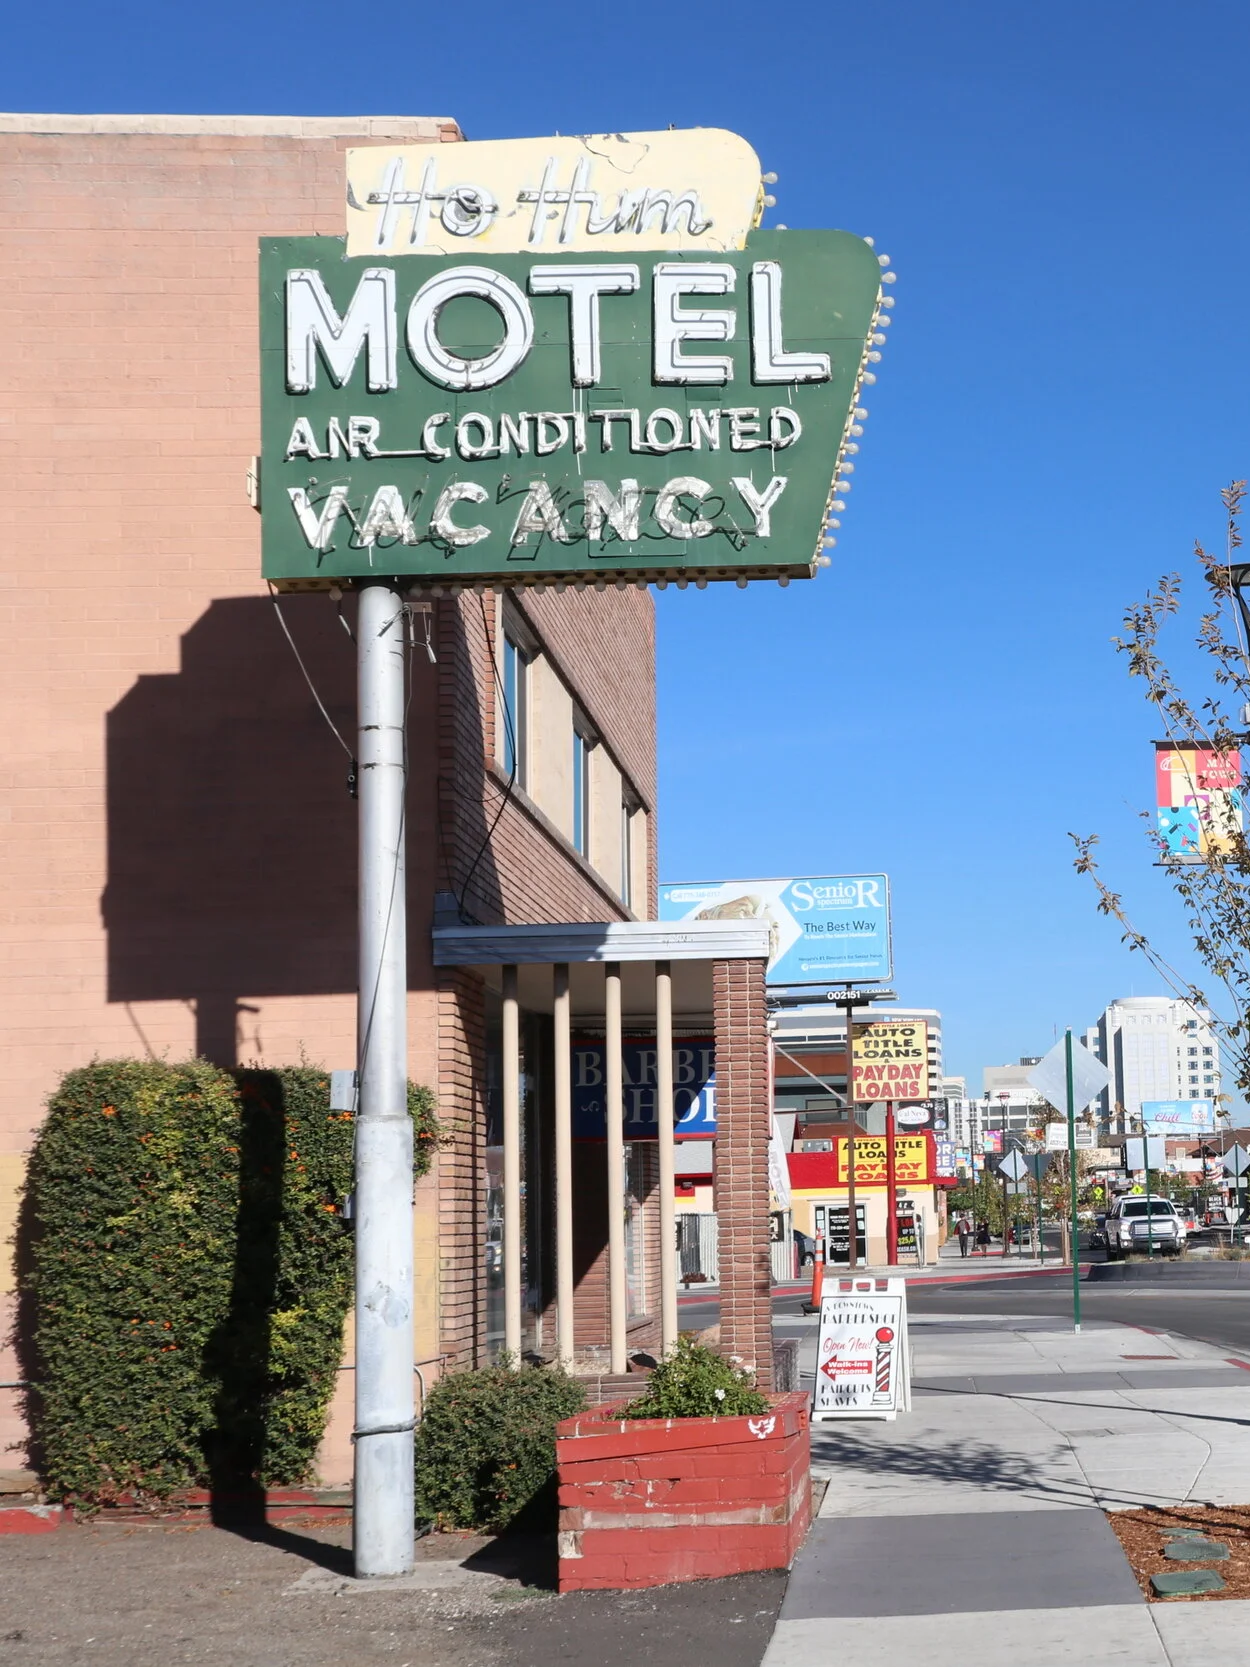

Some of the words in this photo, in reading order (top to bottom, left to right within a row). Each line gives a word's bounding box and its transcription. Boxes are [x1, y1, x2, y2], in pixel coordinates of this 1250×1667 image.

[368, 156, 498, 246] Ho
[519, 156, 714, 246] Hum
[285, 260, 831, 394] MOTEL
[284, 415, 381, 462] AIR
[422, 406, 801, 462] CONDITIONED
[287, 475, 788, 549] VACANCY
[817, 898, 853, 908] spectrum
[804, 922, 824, 932] The
[827, 921, 850, 932] Best
[853, 920, 876, 931] Way
[827, 990, 861, 1000] 002151
[861, 1027, 916, 1038] AUTO
[862, 1039, 914, 1048] TITLE
[853, 1048, 922, 1059] LOANS
[576, 1049, 717, 1087] BARBE
[852, 1064, 924, 1081] PAYDAY
[856, 1081, 920, 1099] LOANS
[1154, 1112, 1180, 1123] Chill
[893, 1141, 923, 1149] ITLE
[858, 1151, 906, 1159] LOAS
[898, 1235, 915, 1245] $25,0
[823, 1337, 846, 1355] Open
[828, 1360, 869, 1368] Walk-ins
